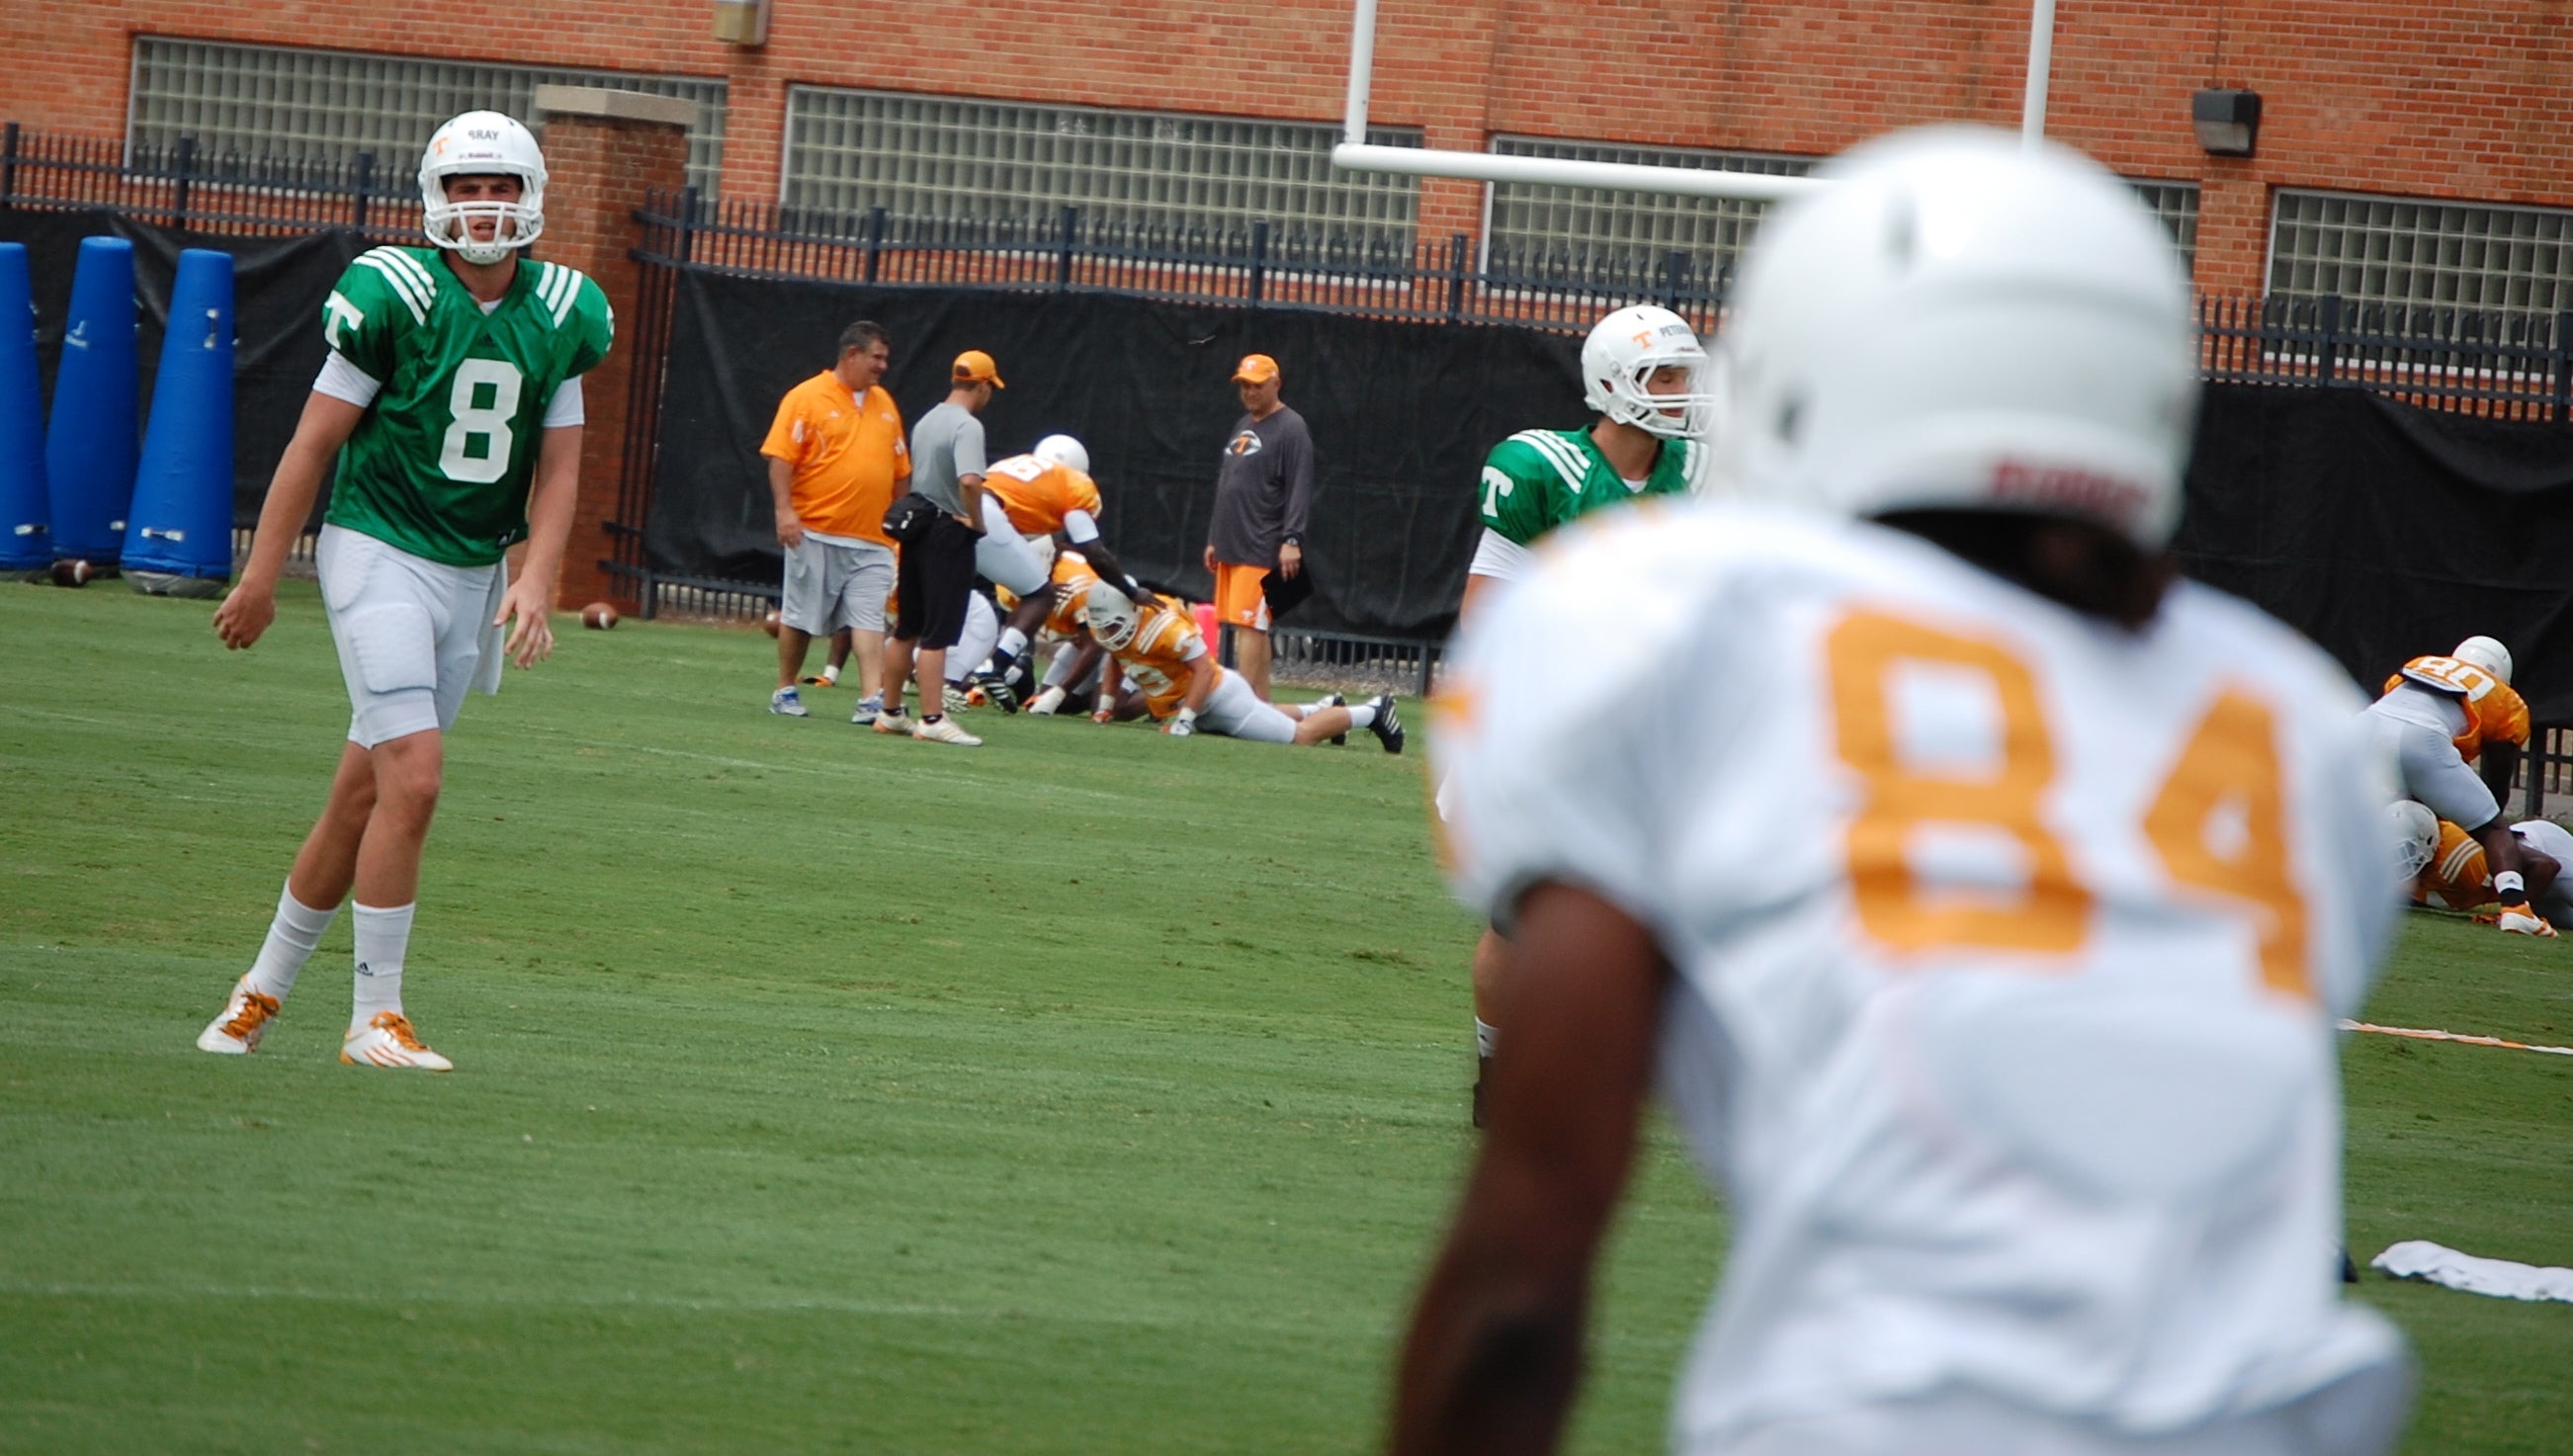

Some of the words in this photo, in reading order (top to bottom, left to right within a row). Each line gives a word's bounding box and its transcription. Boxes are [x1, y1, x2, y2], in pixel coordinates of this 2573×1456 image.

[433, 135, 450, 156] T
[324, 289, 365, 349] T
[1632, 330, 1652, 350] T
[438, 358, 522, 484] 8
[1482, 465, 1514, 518] T
[1817, 603, 2317, 998] 84
